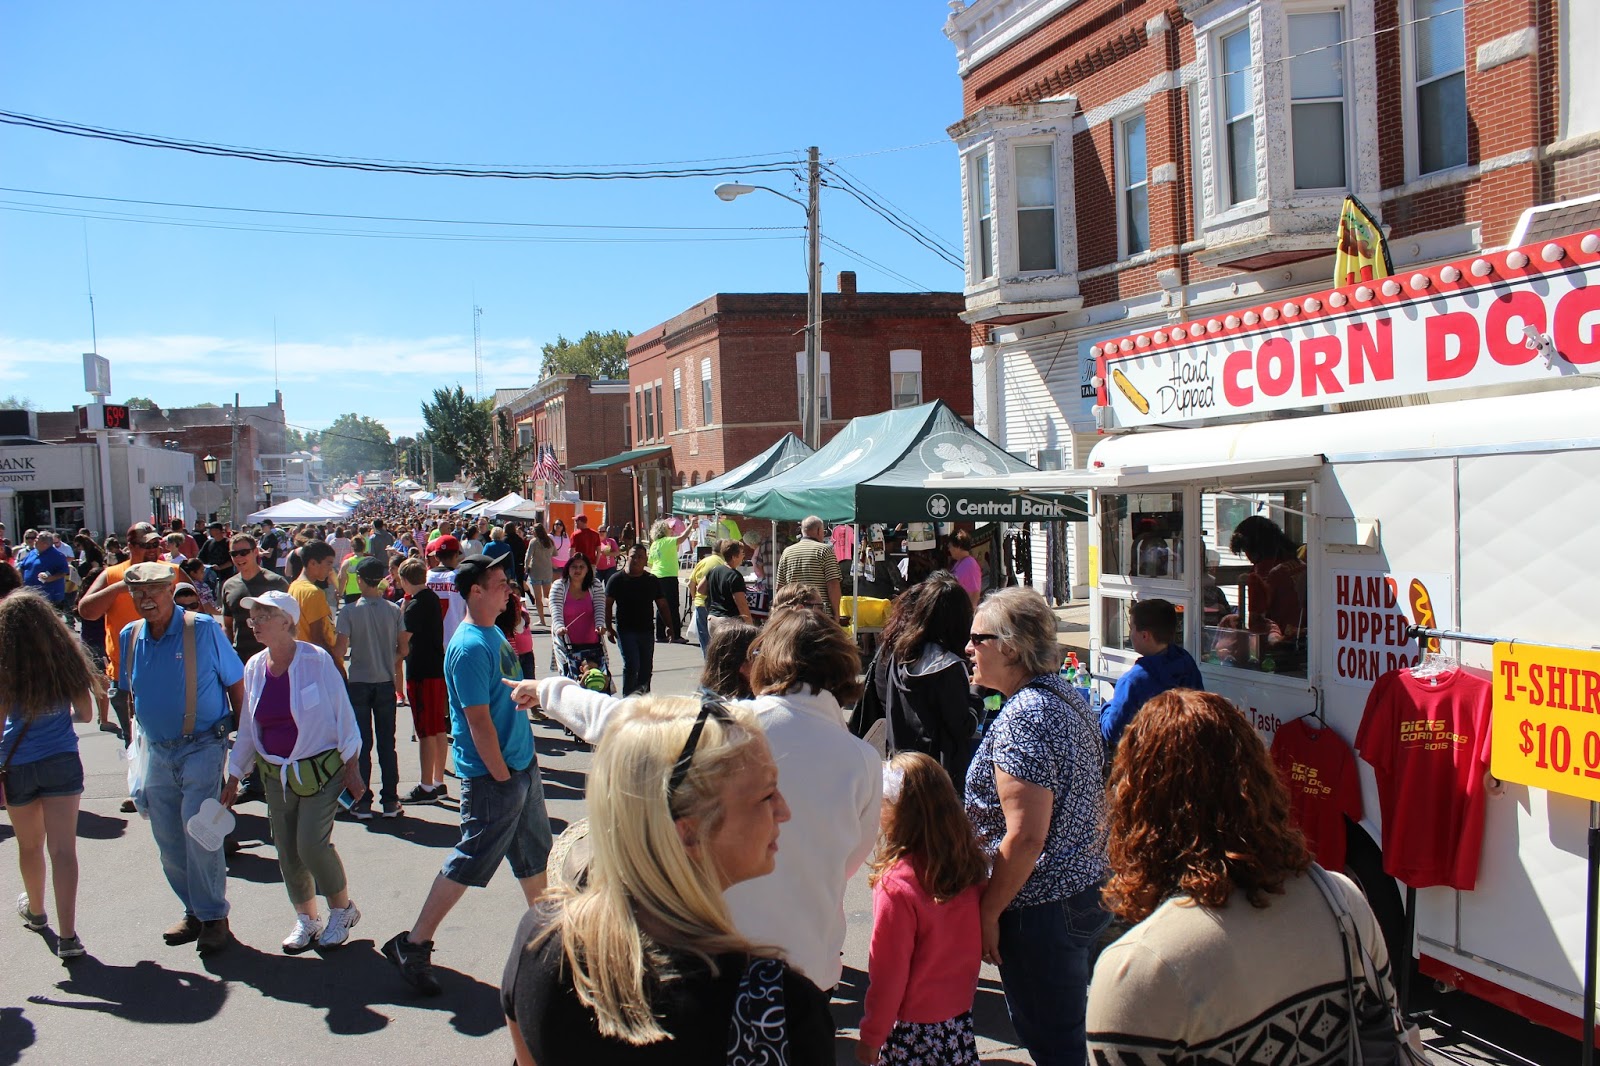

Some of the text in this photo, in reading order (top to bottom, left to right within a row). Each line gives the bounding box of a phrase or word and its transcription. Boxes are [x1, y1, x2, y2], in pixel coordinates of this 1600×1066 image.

[1223, 284, 1600, 407] CORN DOG
[1169, 351, 1209, 387] Hand
[1082, 386, 1097, 397] TAN
[1157, 376, 1215, 418] Dipped
[956, 498, 1065, 517] Central Bank
[1337, 575, 1398, 609] HAND
[1337, 609, 1410, 647] DIPPED
[1337, 646, 1381, 682] CORN
[1501, 660, 1600, 715] T-SHIR
[1250, 707, 1281, 734] Taste
[1436, 732, 1468, 744] DOGS
[1424, 742, 1449, 751] 2015
